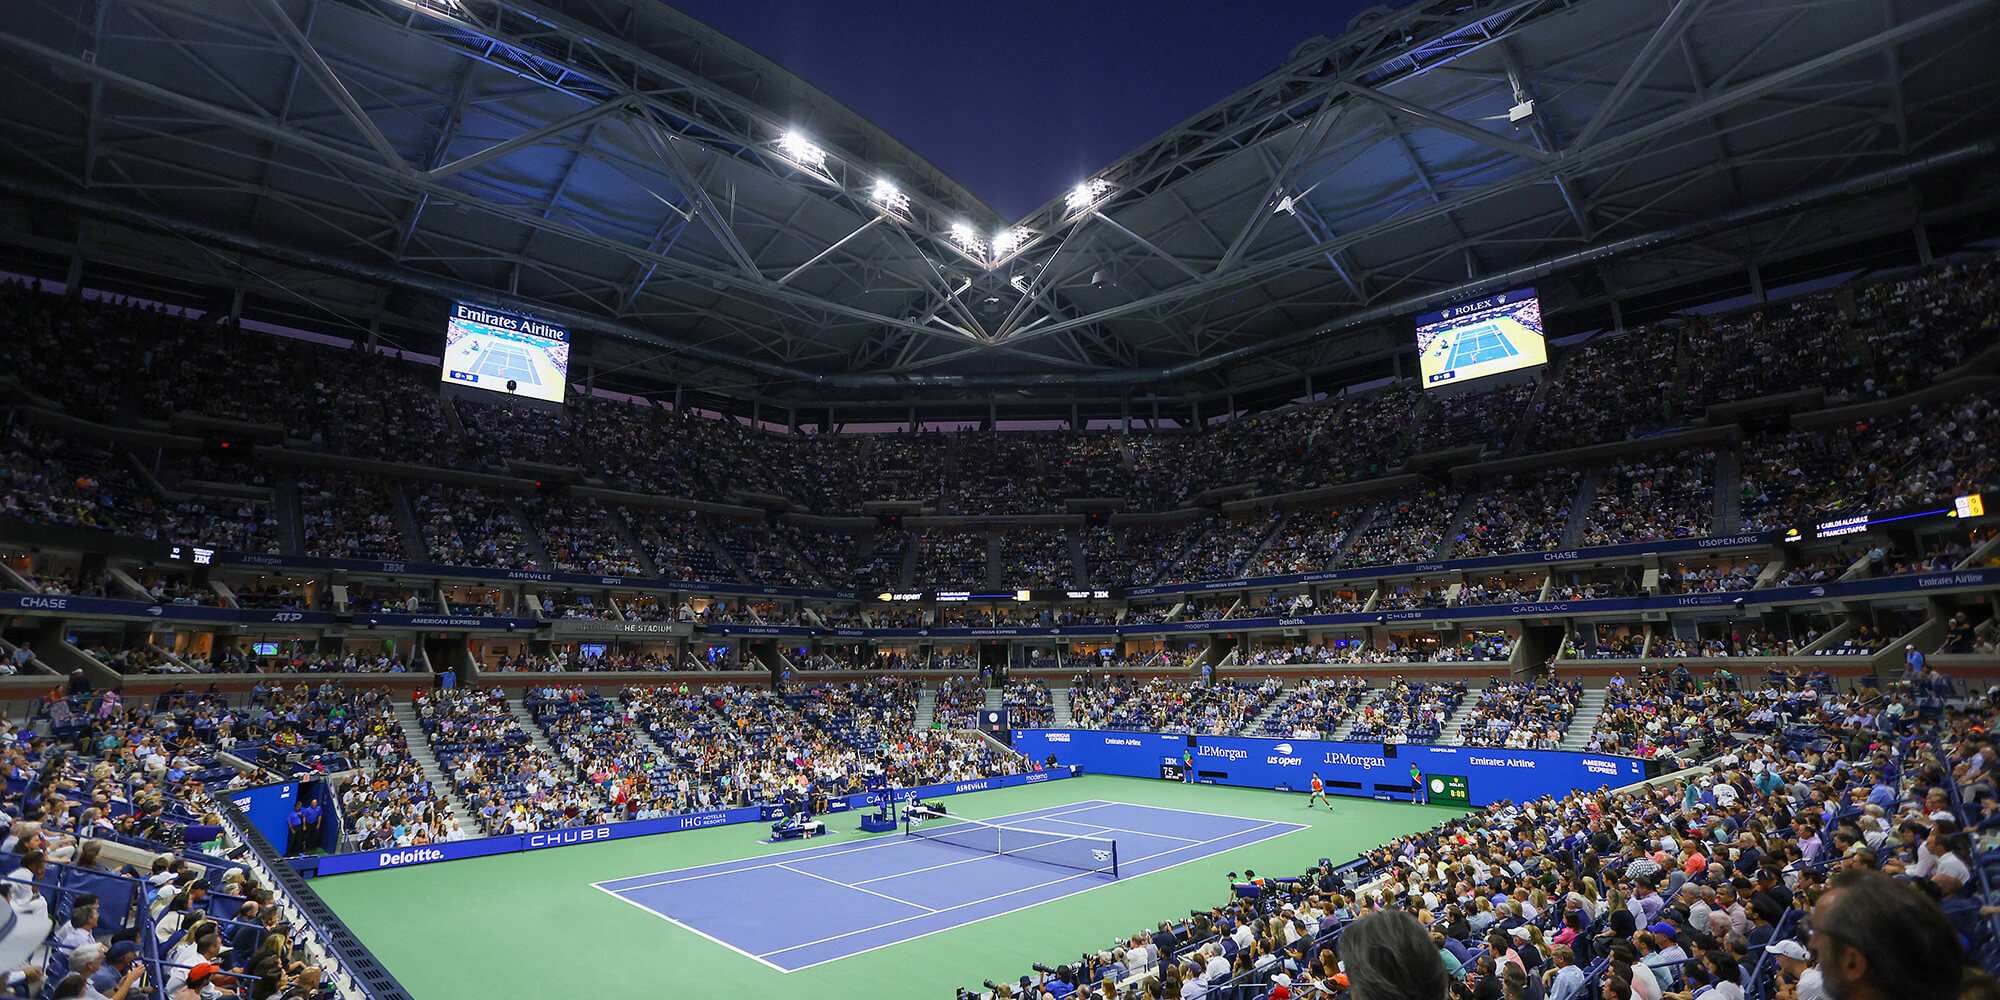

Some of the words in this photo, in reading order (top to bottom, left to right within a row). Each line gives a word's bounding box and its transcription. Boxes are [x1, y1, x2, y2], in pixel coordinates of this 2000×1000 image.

[1455, 299, 1492, 316] ROLEX
[457, 305, 517, 330] Emirates
[520, 322, 564, 340] Airline
[1821, 519, 1842, 530] CARLOS
[1842, 515, 1868, 526] ALCARAZ
[1823, 528, 1847, 538] FRANCES
[1847, 525, 1867, 534] TIAFOE
[1698, 535, 1758, 547] USOPEN.ORG
[193, 554, 211, 565] IBM
[1544, 551, 1578, 561] CHASE
[383, 563, 406, 573] IBM
[508, 571, 552, 581] ASHEVILLE
[1918, 576, 1953, 587] Emirates
[1955, 574, 1983, 584] Airline
[836, 591, 855, 599] CHASE
[893, 593, 903, 601] us
[903, 593, 921, 602] open
[21, 597, 67, 609] CHASE
[1678, 597, 1698, 605] IHG
[1512, 604, 1568, 613] CADILLAC
[272, 612, 303, 622] ATP
[1279, 618, 1306, 626] Deloitte.
[638, 624, 673, 633] STADIUM
[1197, 745, 1248, 761] J.P.Morgan
[1165, 757, 1177, 765] IBM
[1267, 756, 1278, 764] us
[1278, 756, 1302, 767] open
[1323, 752, 1386, 770] J.P.Morgan
[1469, 756, 1505, 767] Emirates
[1506, 758, 1536, 769] Airline
[1582, 759, 1616, 768] AMERICAN
[1163, 766, 1174, 776] 75
[1588, 765, 1618, 775] EXPRESS
[1026, 773, 1048, 781] moderna
[956, 781, 988, 793] ASHEVILLE
[1450, 789, 1466, 798] 0:00
[680, 816, 702, 828] IHG
[530, 827, 610, 847] CHUBB
[379, 848, 444, 867] Deloitte.
